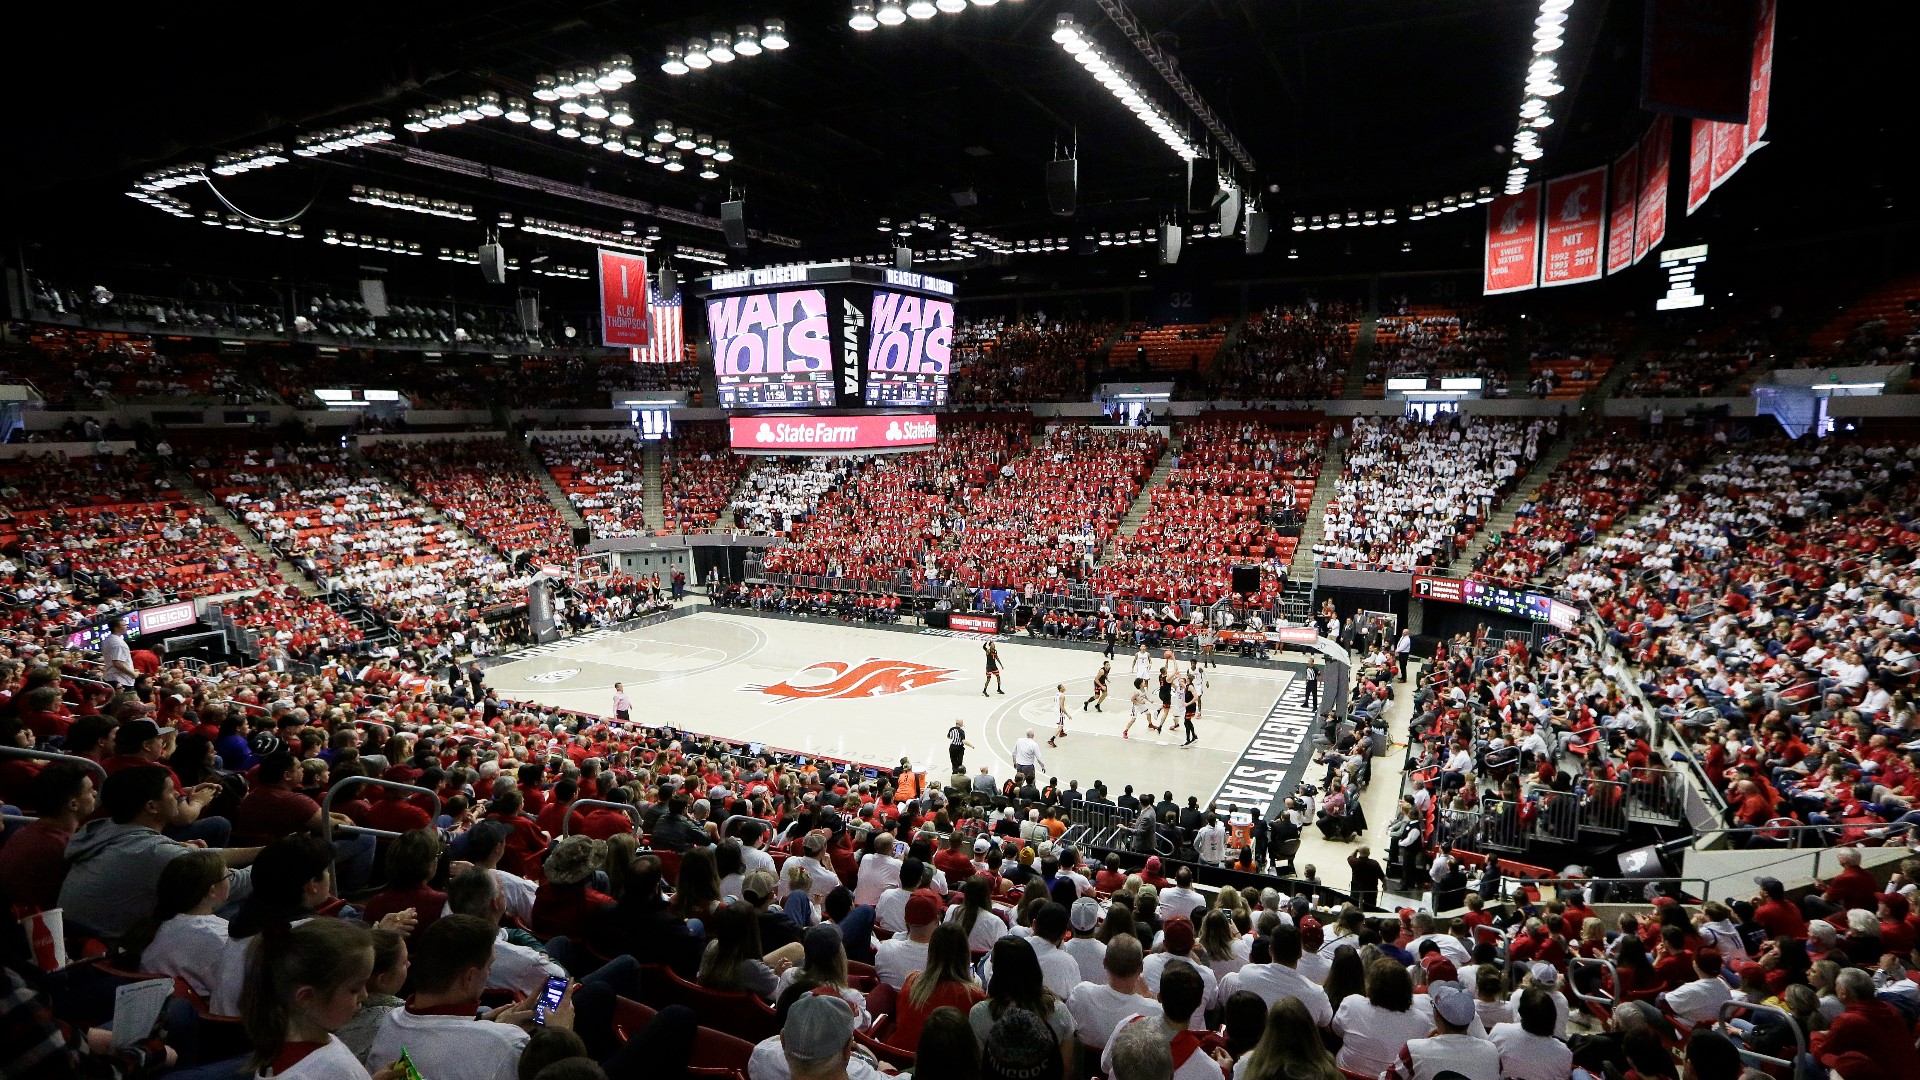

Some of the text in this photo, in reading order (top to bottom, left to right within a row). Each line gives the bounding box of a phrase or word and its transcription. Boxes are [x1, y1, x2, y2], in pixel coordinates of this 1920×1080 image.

[1562, 233, 1583, 247] NIT
[1500, 246, 1522, 256] SWEET
[1575, 247, 1595, 258] 2009
[1498, 254, 1525, 265] SIXTEEN
[621, 265, 628, 299] 1
[711, 266, 807, 290] BEASLEY COLISEUM
[887, 269, 954, 295] BEASLEY COLISEUM
[1169, 292, 1193, 308] 32
[616, 304, 635, 317] KLAY
[606, 315, 646, 330] THOMPSON
[844, 298, 864, 396] AVISTA
[776, 423, 856, 443] StateFarm
[1433, 580, 1460, 589] PULLMAN
[1432, 593, 1460, 601] HOSPITAL
[148, 610, 188, 626] BECU
[950, 617, 997, 629] WASHINGTON STATE
[1243, 679, 1325, 765] WASHINGTON
[1235, 829, 1244, 838] G
